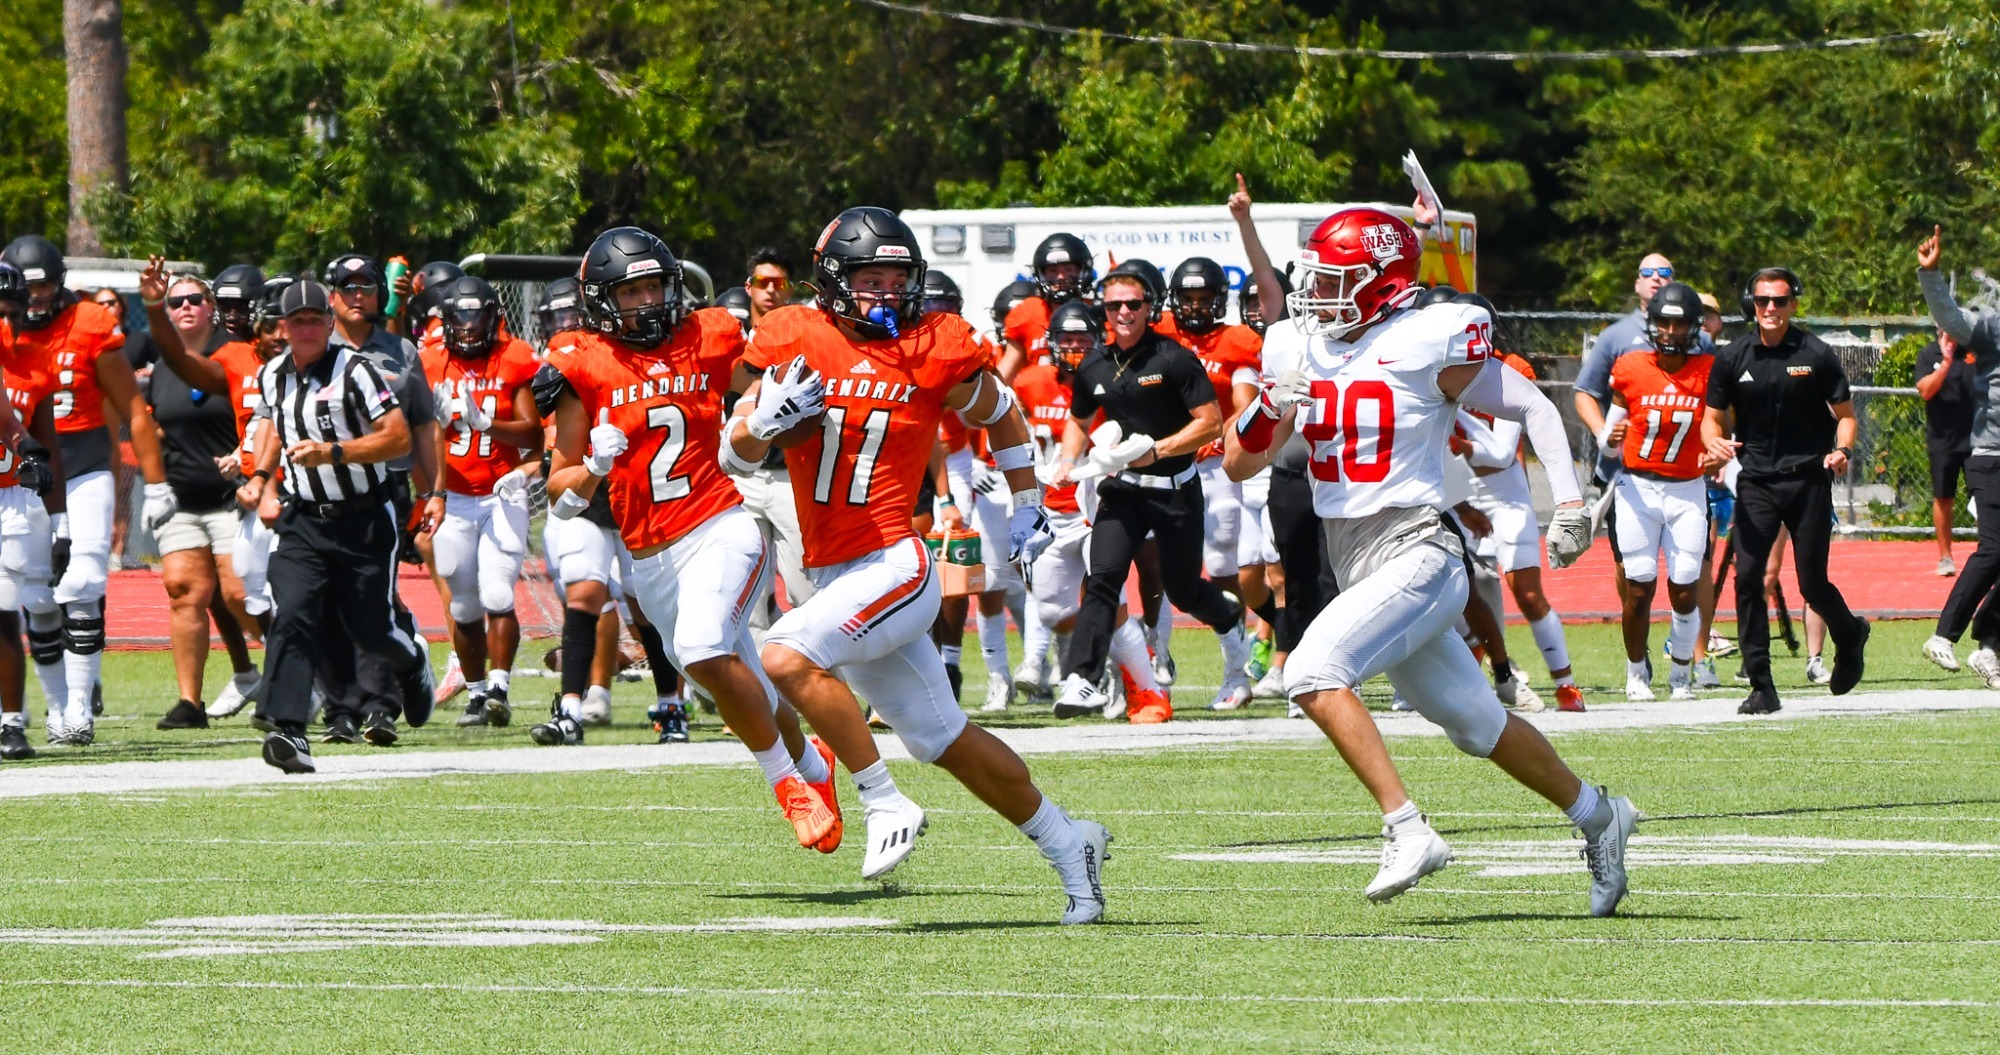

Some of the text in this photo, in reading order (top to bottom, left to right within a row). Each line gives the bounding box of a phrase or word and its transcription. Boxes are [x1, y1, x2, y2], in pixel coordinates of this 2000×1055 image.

[1104, 231, 1142, 244] GOD
[1146, 231, 1171, 244] WE
[1179, 230, 1233, 243] TRUST
[1361, 232, 1402, 251] WASH
[611, 373, 710, 408] HENDRIX
[823, 377, 918, 403] ENDRIX
[1640, 394, 1701, 409] HENDRIX
[1303, 380, 1395, 482] 20
[1638, 408, 1694, 463] 17
[646, 403, 692, 504] 2
[814, 404, 892, 506] 11
